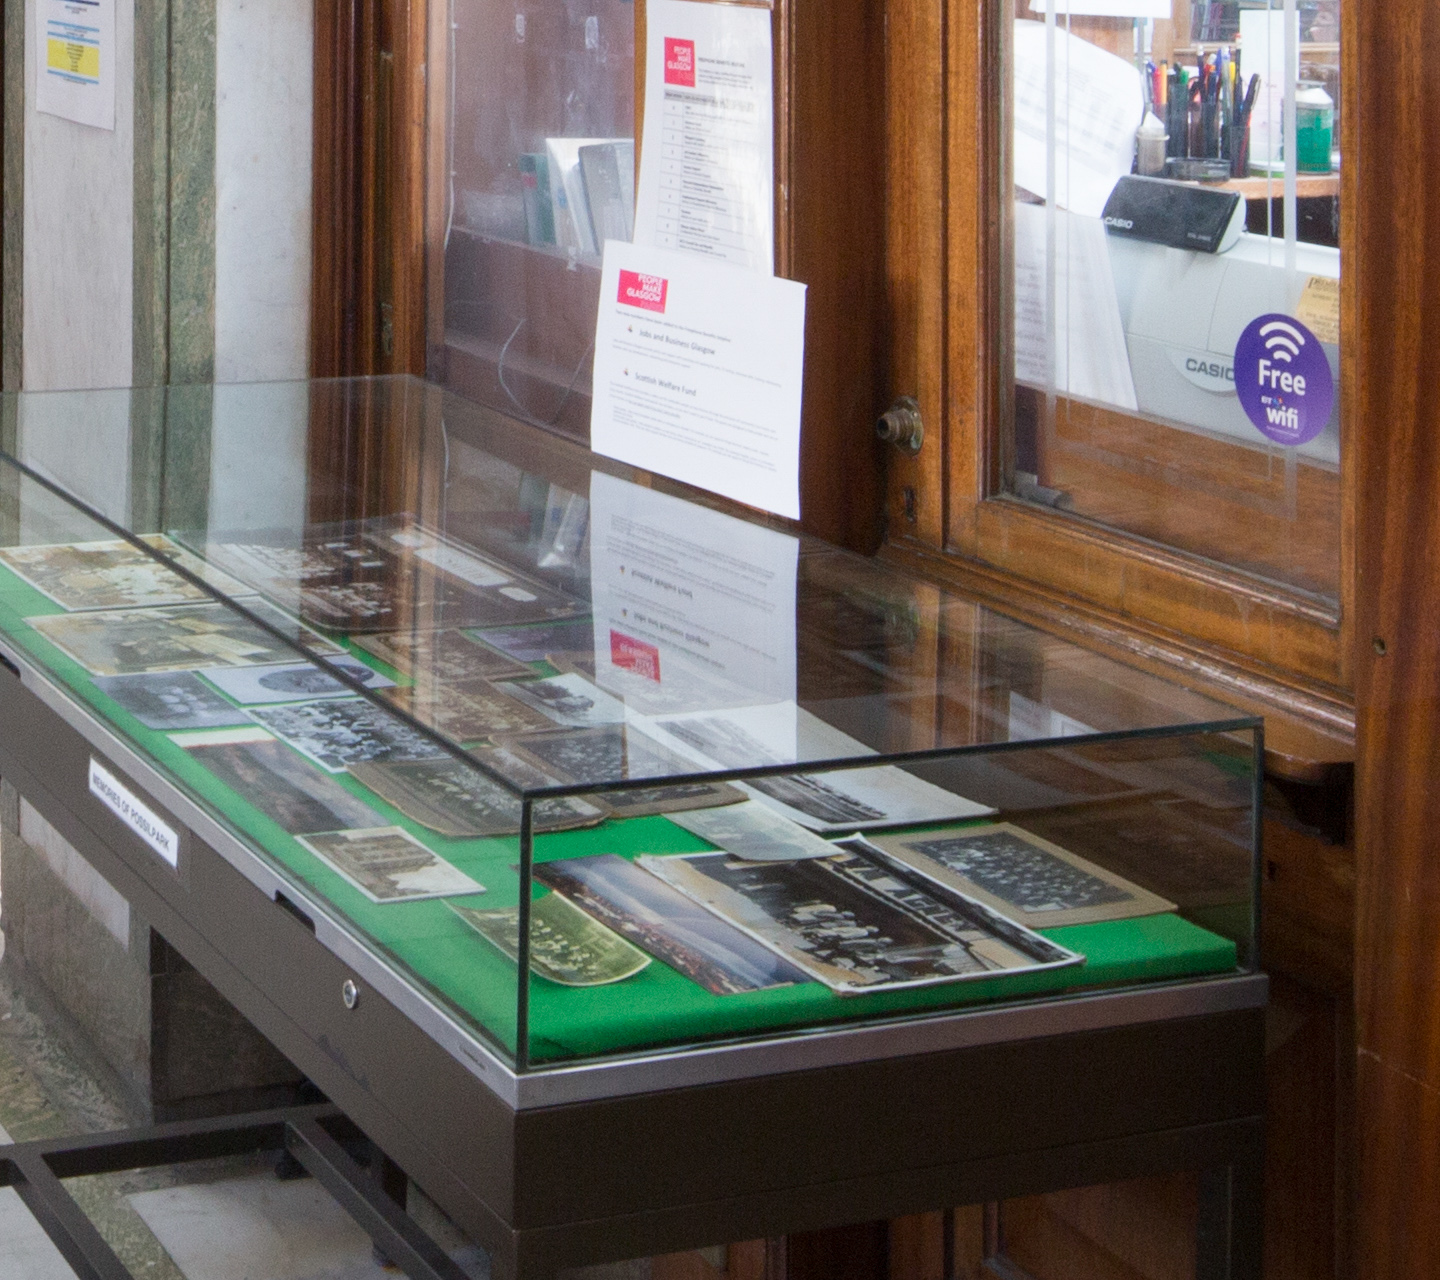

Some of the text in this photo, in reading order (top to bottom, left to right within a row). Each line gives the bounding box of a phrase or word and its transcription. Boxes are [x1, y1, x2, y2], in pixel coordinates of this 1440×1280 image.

[673, 45, 692, 56] PEOPLE
[667, 60, 692, 71] GLASGOW
[677, 54, 692, 64] MAKE
[1104, 215, 1133, 229] CASIO
[637, 273, 663, 286] PEOPLE
[642, 283, 662, 293] MAKE
[626, 288, 661, 303] GLASGOW
[639, 329, 715, 356] Jobs and Business Glasgow
[634, 371, 697, 396] Scottish Welfare Fund
[1258, 358, 1307, 397] Free
[1261, 395, 1272, 405] BT
[1266, 406, 1299, 430] wifi
[93, 772, 169, 851] MEMORIES OF POSSILPARK
